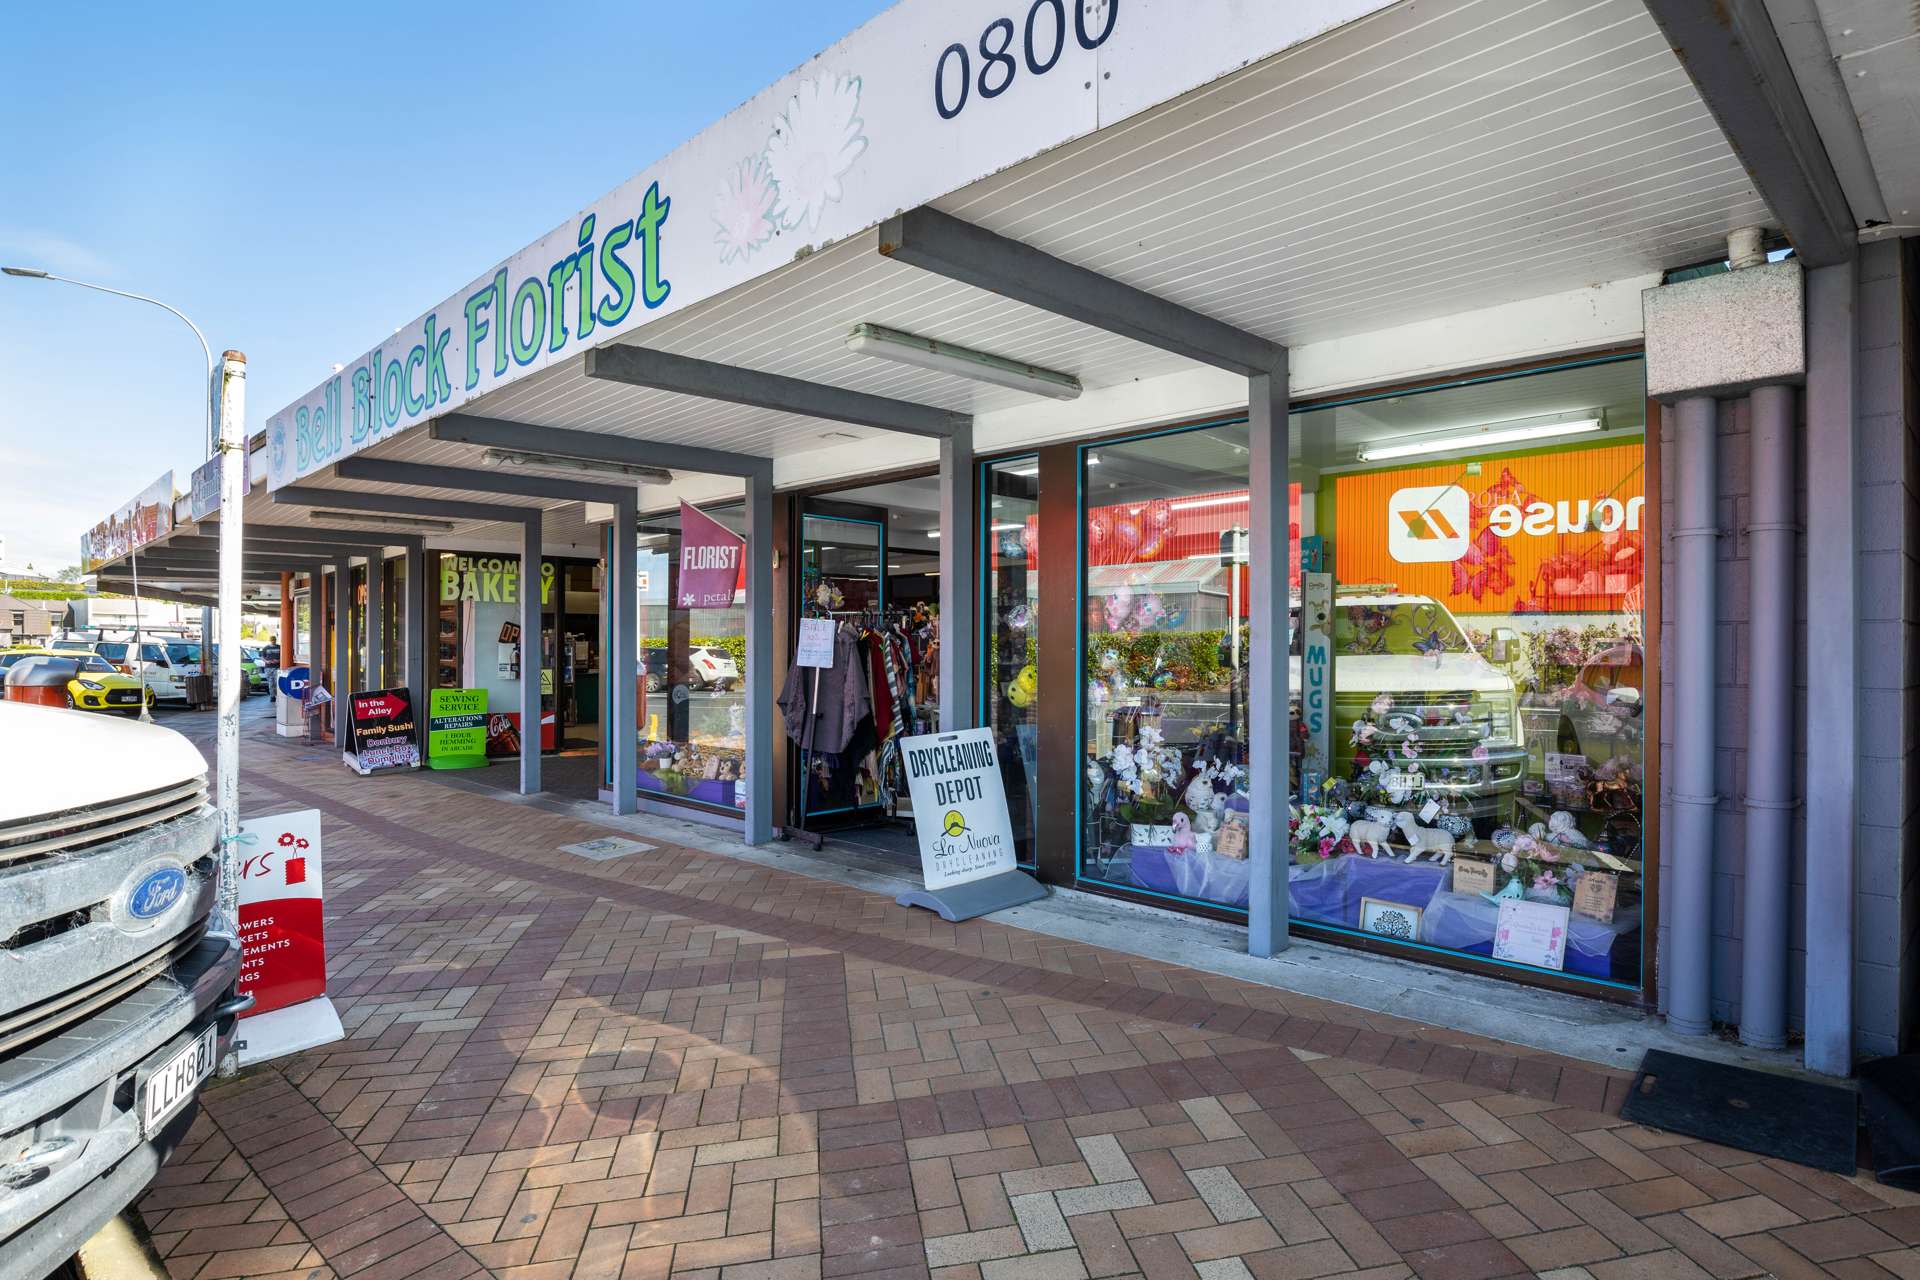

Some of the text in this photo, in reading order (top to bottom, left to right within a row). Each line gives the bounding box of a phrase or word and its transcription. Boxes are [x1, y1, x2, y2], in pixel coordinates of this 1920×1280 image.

[935, 0, 1118, 119] 0800
[295, 180, 671, 472] Bell Block Florist
[443, 557, 521, 575] WELCOM
[683, 545, 738, 570] FLORIST
[441, 571, 555, 604] BAKEY
[440, 695, 480, 703] SEWING
[1306, 645, 1327, 734] MUGS
[358, 701, 368, 709] In
[368, 707, 392, 716] Alley
[440, 703, 480, 711] SERVICE
[356, 721, 414, 737] Family Sushi
[433, 715, 483, 725] ALTERATIONS
[444, 721, 473, 729] REPAIRS
[908, 740, 994, 778] DRYCLEANING
[934, 776, 984, 806] DEPOT
[932, 832, 1001, 860] La Nuova
[142, 877, 178, 914] Ford
